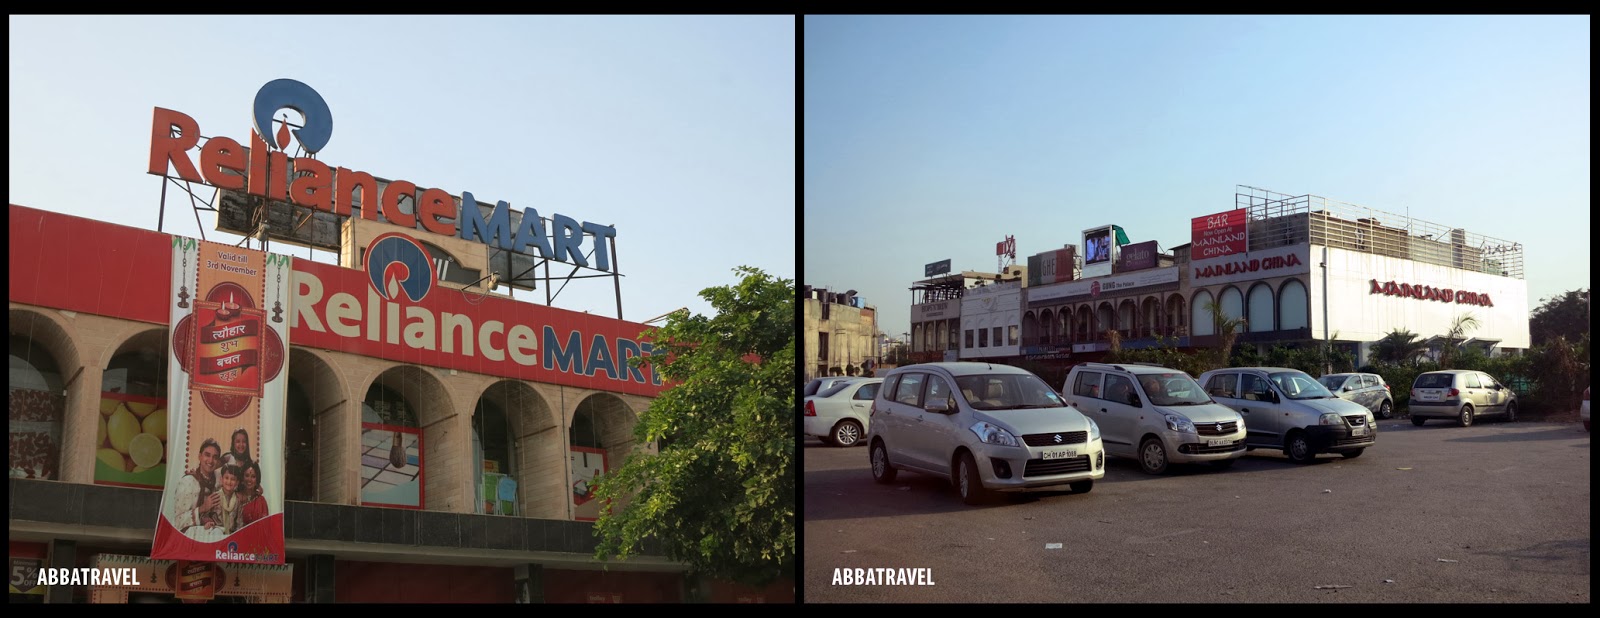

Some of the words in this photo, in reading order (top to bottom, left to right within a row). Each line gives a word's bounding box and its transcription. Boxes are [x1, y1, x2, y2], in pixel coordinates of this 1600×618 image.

[148, 105, 458, 236] Reliance
[460, 191, 616, 272] MART
[1207, 213, 1229, 229] BAR
[1192, 232, 1245, 248] MAINLAND
[217, 251, 236, 261] Valid
[238, 255, 248, 263] till
[1203, 245, 1232, 256] CHINA
[207, 260, 219, 269] 3rd
[220, 263, 257, 276] November
[1195, 258, 1260, 279] MAINLAND
[1261, 253, 1302, 271] CHINA
[1369, 278, 1454, 303] MAINLAND
[1455, 289, 1494, 307] CHINA
[212, 325, 246, 340] त्यौहार
[289, 269, 538, 367] Reliance
[543, 325, 667, 386] MART
[220, 340, 238, 352] शुभ
[216, 354, 241, 367] बचत
[215, 549, 255, 560] Reliance
